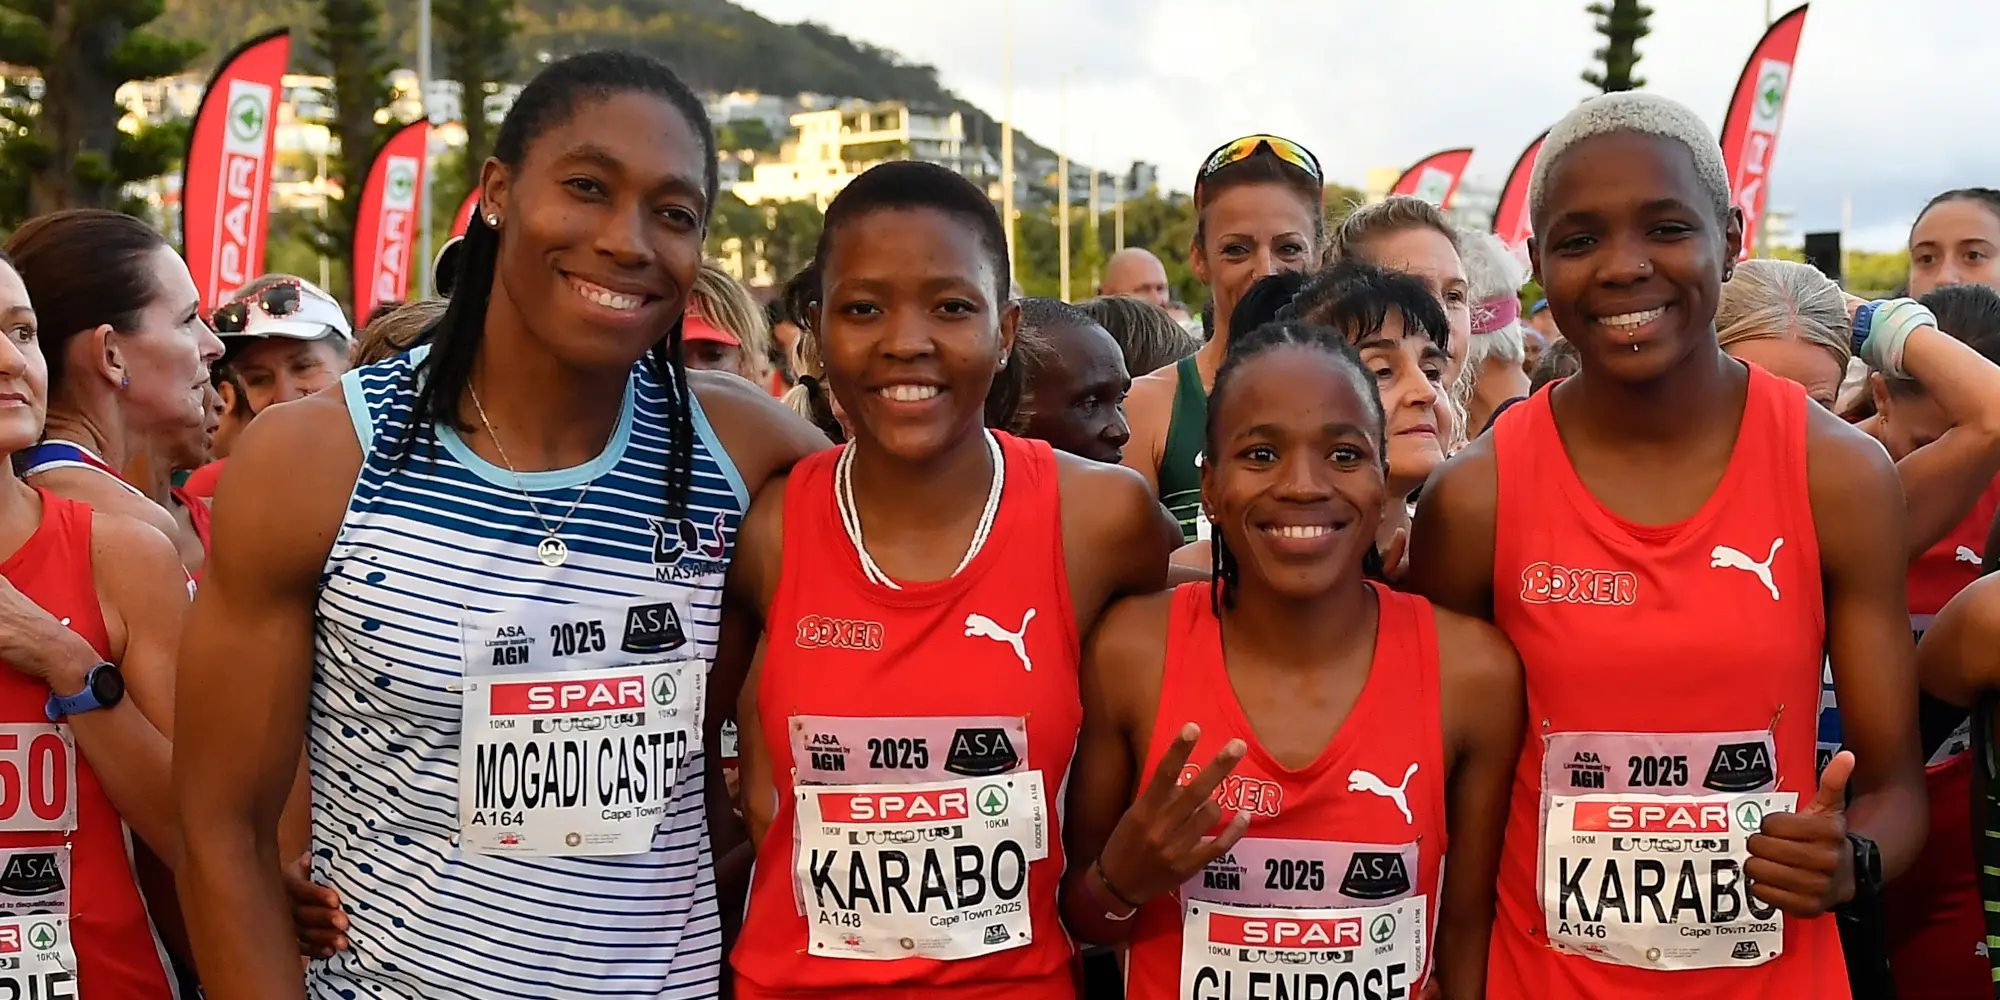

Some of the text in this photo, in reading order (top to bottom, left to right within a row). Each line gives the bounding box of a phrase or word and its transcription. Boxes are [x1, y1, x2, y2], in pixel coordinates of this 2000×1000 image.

[218, 156, 255, 307] PAR
[375, 213, 405, 301] PAR
[1521, 562, 1637, 605] BOXER
[628, 606, 679, 635] ASA
[496, 625, 526, 639] ASA
[550, 619, 606, 657] 2025
[796, 614, 884, 651] BOXER
[492, 645, 529, 666] AGN
[527, 680, 644, 710] SPAR
[489, 719, 515, 729] 10KM
[812, 733, 840, 746] ASA
[954, 733, 1009, 756] ASA
[811, 752, 846, 771] AGN
[867, 738, 929, 769] 2025
[1573, 751, 1600, 763] ASA
[1714, 747, 1767, 773] ASA
[475, 740, 588, 809] MOGADI
[1570, 770, 1604, 789] AGN
[1628, 755, 1688, 787] 2025
[601, 809, 632, 822] Cape
[634, 806, 662, 818] Town
[850, 793, 967, 820] SPAR
[1607, 806, 1728, 829] SPAR
[472, 811, 524, 826] A164
[984, 819, 1009, 829] 10KM
[821, 826, 841, 836] 10KM
[1572, 836, 1596, 845] 10KM
[8, 858, 55, 878] ASA
[810, 839, 1026, 914] KARABO
[1264, 858, 1324, 891] 2025
[1350, 857, 1403, 880] ASA
[1203, 871, 1240, 891] AGN
[818, 910, 862, 928] A148
[930, 901, 1022, 928] Cape Town 2025
[1243, 921, 1359, 945] SPAR
[1558, 921, 1607, 938] A146
[1680, 923, 1777, 938] Cape Town 2025
[1208, 946, 1231, 957] 10KM
[1374, 944, 1394, 957] 10KM
